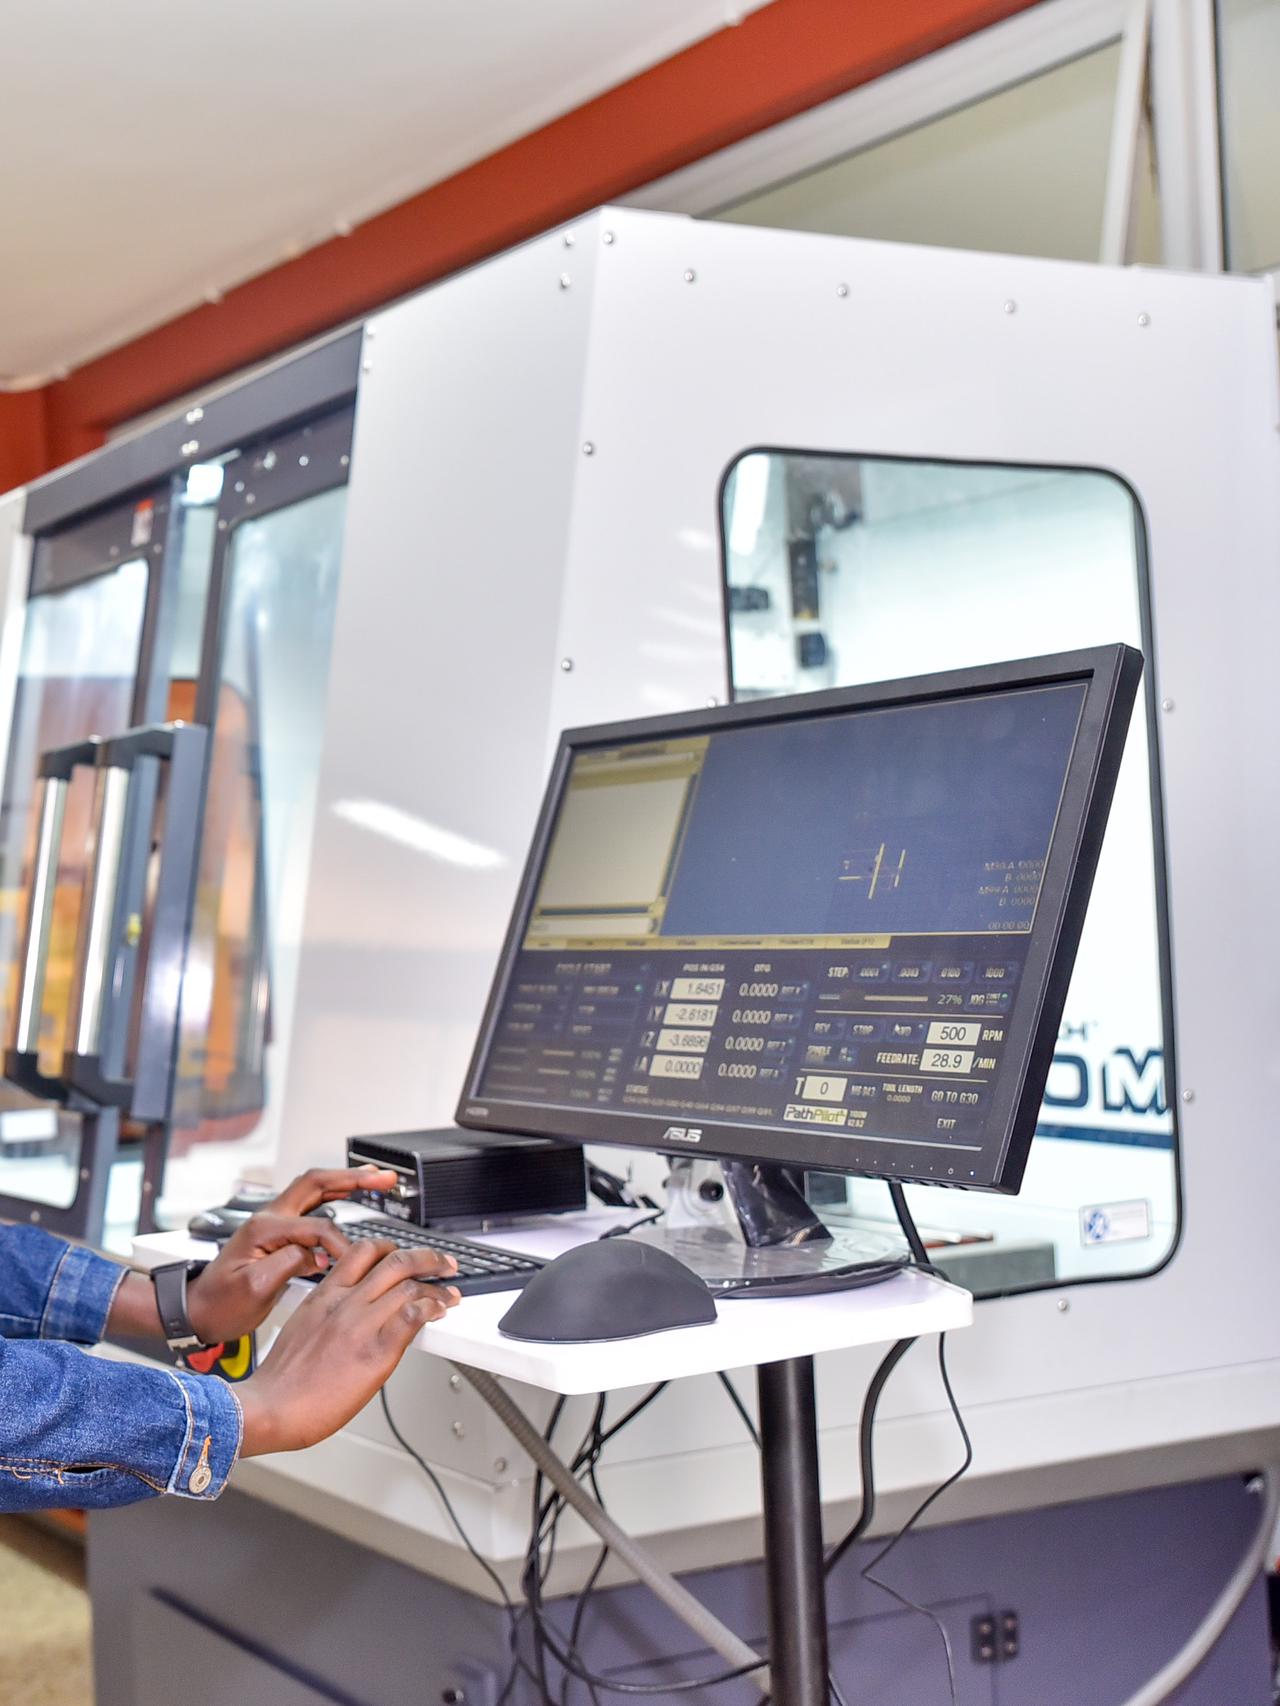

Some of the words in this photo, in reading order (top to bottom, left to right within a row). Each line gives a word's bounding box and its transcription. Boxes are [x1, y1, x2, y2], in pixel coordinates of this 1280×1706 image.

[739, 983, 779, 997] 0.0000
[937, 994, 963, 1004] 27%
[732, 1010, 771, 1024] 0.0000
[939, 1027, 966, 1041] 500
[982, 1030, 1004, 1041] RPM
[725, 1036, 764, 1051] 0.0000
[876, 1052, 920, 1065] FEEDRATE:
[931, 1053, 962, 1069] 28.9
[972, 1056, 997, 1070] /MIN
[718, 1063, 757, 1079] 0.0000
[795, 1077, 805, 1096] T
[820, 1081, 829, 1095] 0
[898, 1083, 923, 1094] LENGTH
[931, 1090, 944, 1103] GO
[945, 1090, 958, 1104] TO
[960, 1091, 979, 1105] G30
[785, 1105, 846, 1123] PathPilot
[937, 1118, 957, 1129] EXIT
[662, 1126, 703, 1143] ASUS
